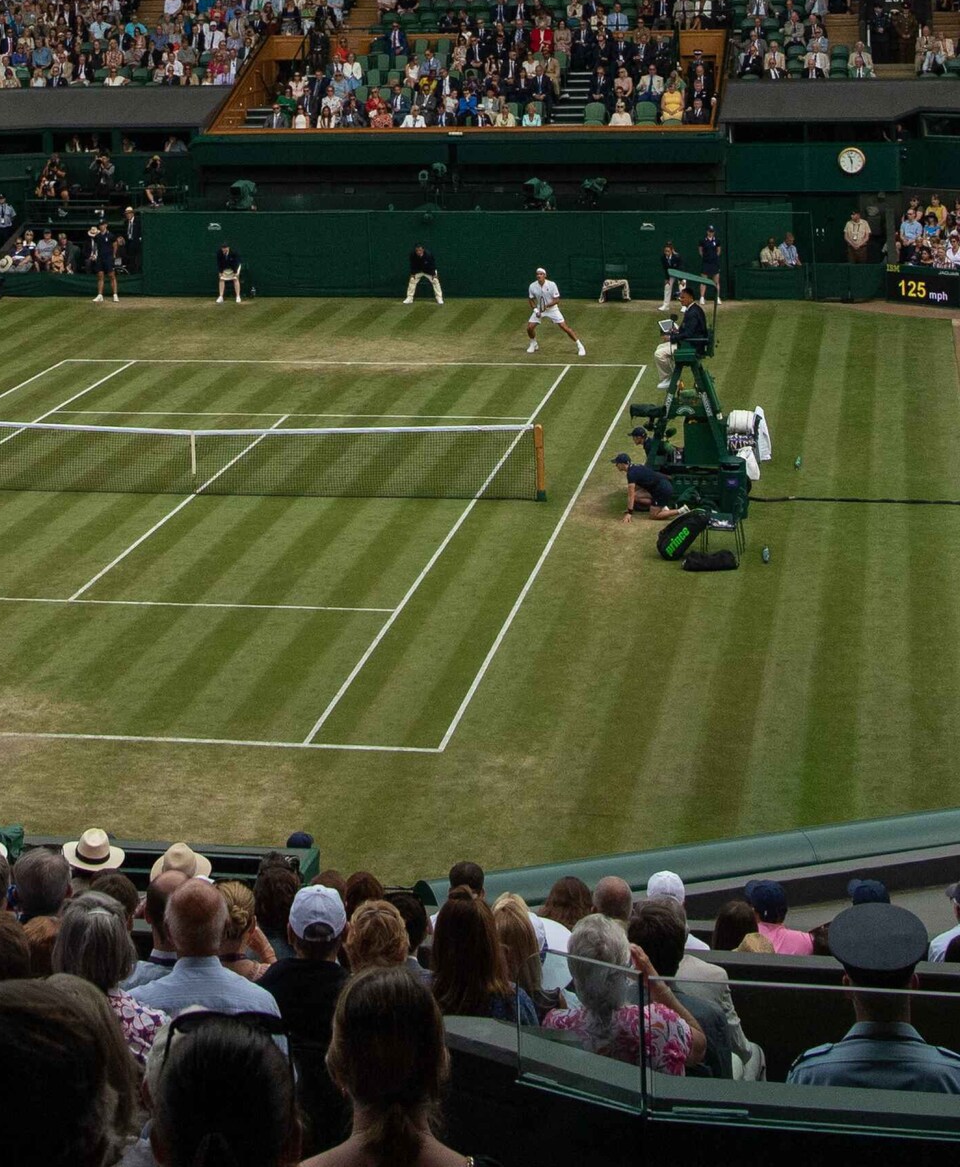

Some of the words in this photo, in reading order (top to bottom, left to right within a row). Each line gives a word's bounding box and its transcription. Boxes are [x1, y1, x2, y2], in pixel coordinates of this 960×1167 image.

[898, 279, 927, 298] 125
[928, 291, 948, 302] mph
[665, 527, 690, 557] prince
